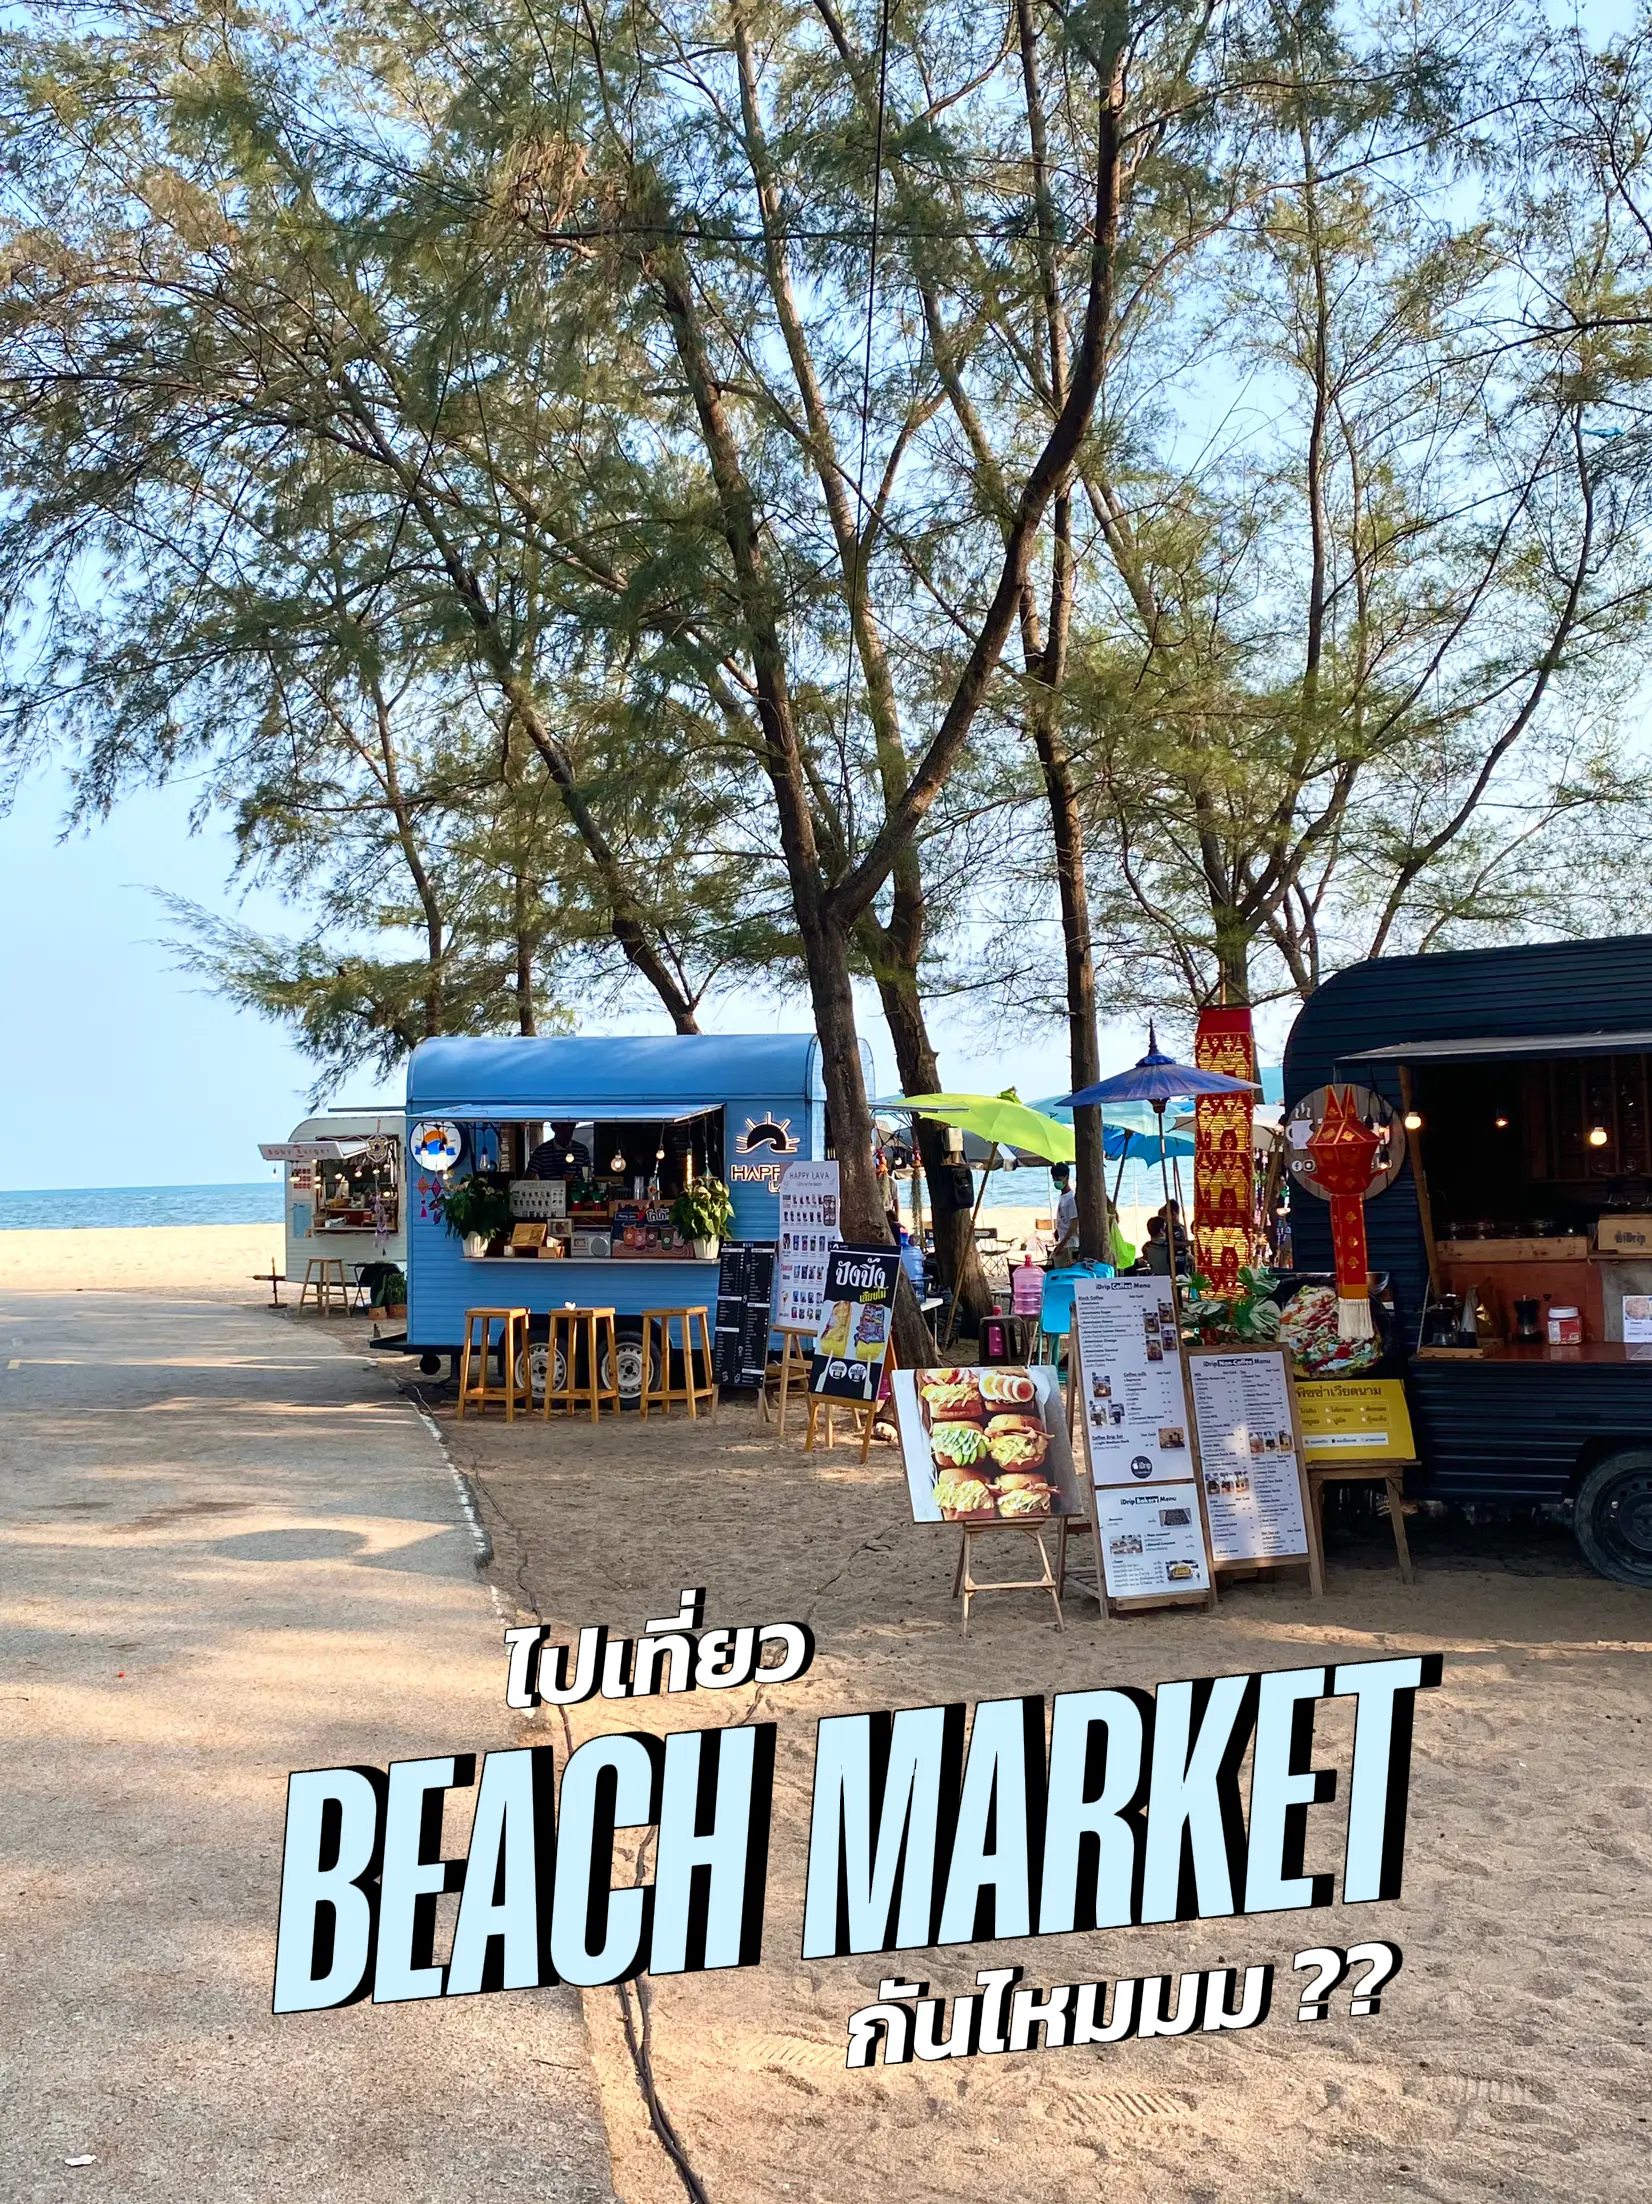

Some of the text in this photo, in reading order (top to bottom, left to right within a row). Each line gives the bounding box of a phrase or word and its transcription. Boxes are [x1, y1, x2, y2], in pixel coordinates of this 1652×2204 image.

[790, 1171, 830, 1180] HAPPY LAVA
[836, 1258, 888, 1289] ปังปิ้ง
[1096, 1283, 1111, 1291] iDrip
[1112, 1282, 1132, 1290] Coffee
[1203, 1361, 1218, 1369] iDrip
[1120, 1498, 1135, 1506] iDrip
